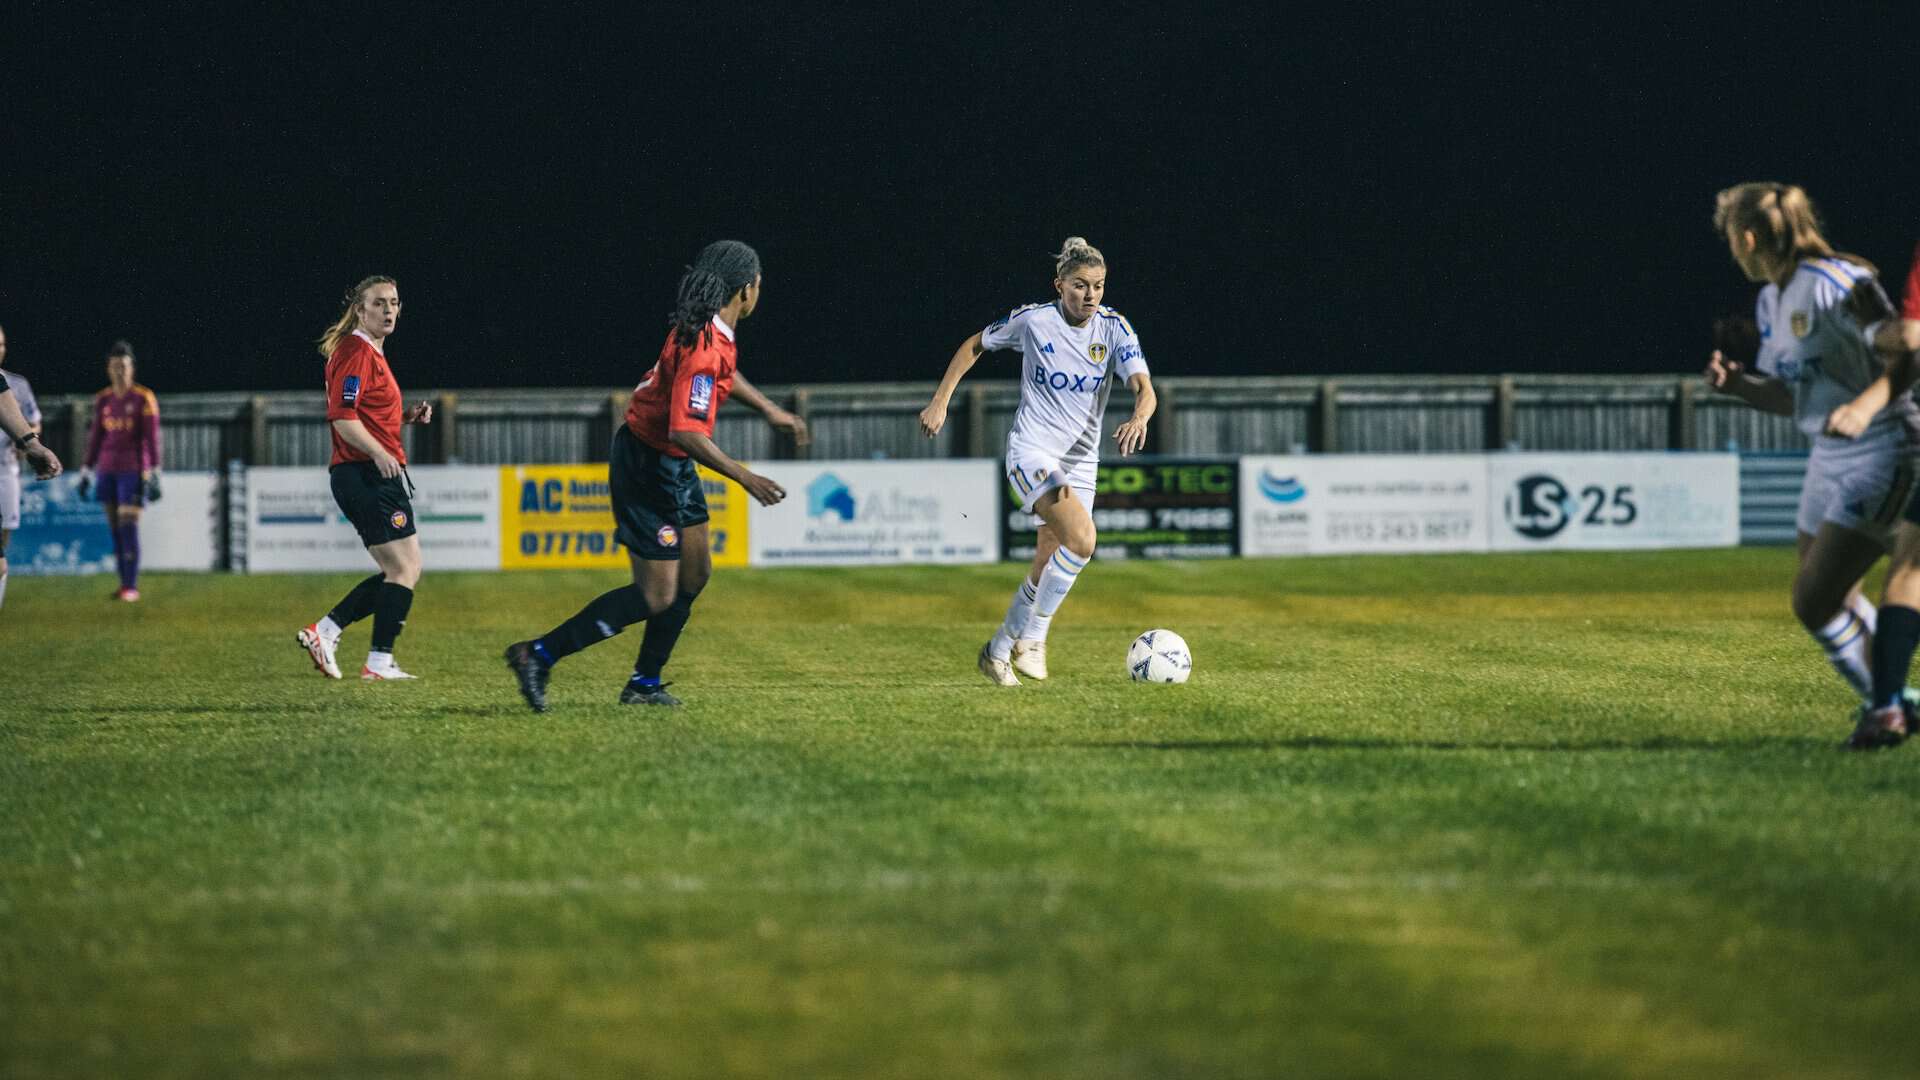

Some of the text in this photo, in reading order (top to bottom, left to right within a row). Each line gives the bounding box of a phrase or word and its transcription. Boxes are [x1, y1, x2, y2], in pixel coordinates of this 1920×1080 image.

[1034, 365, 1106, 393] BOXT
[521, 479, 563, 513] AC
[1580, 485, 1637, 525] 25
